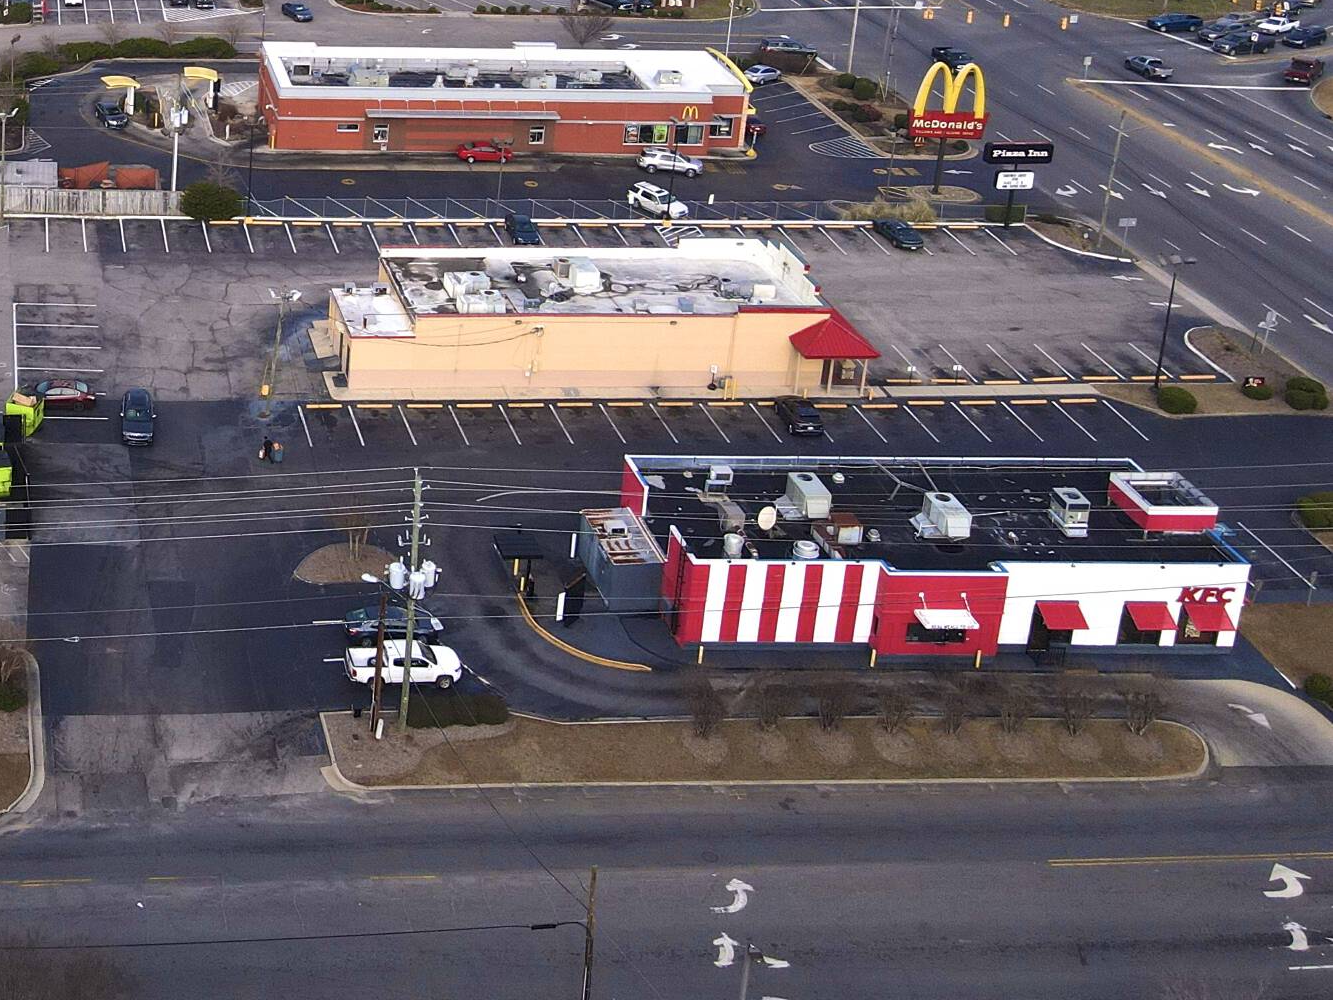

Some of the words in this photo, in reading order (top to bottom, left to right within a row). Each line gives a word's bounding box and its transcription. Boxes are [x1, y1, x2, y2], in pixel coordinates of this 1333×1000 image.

[912, 119, 983, 130] McDonald's
[992, 150, 1026, 158] Pizza
[1175, 586, 1236, 603] KFC
